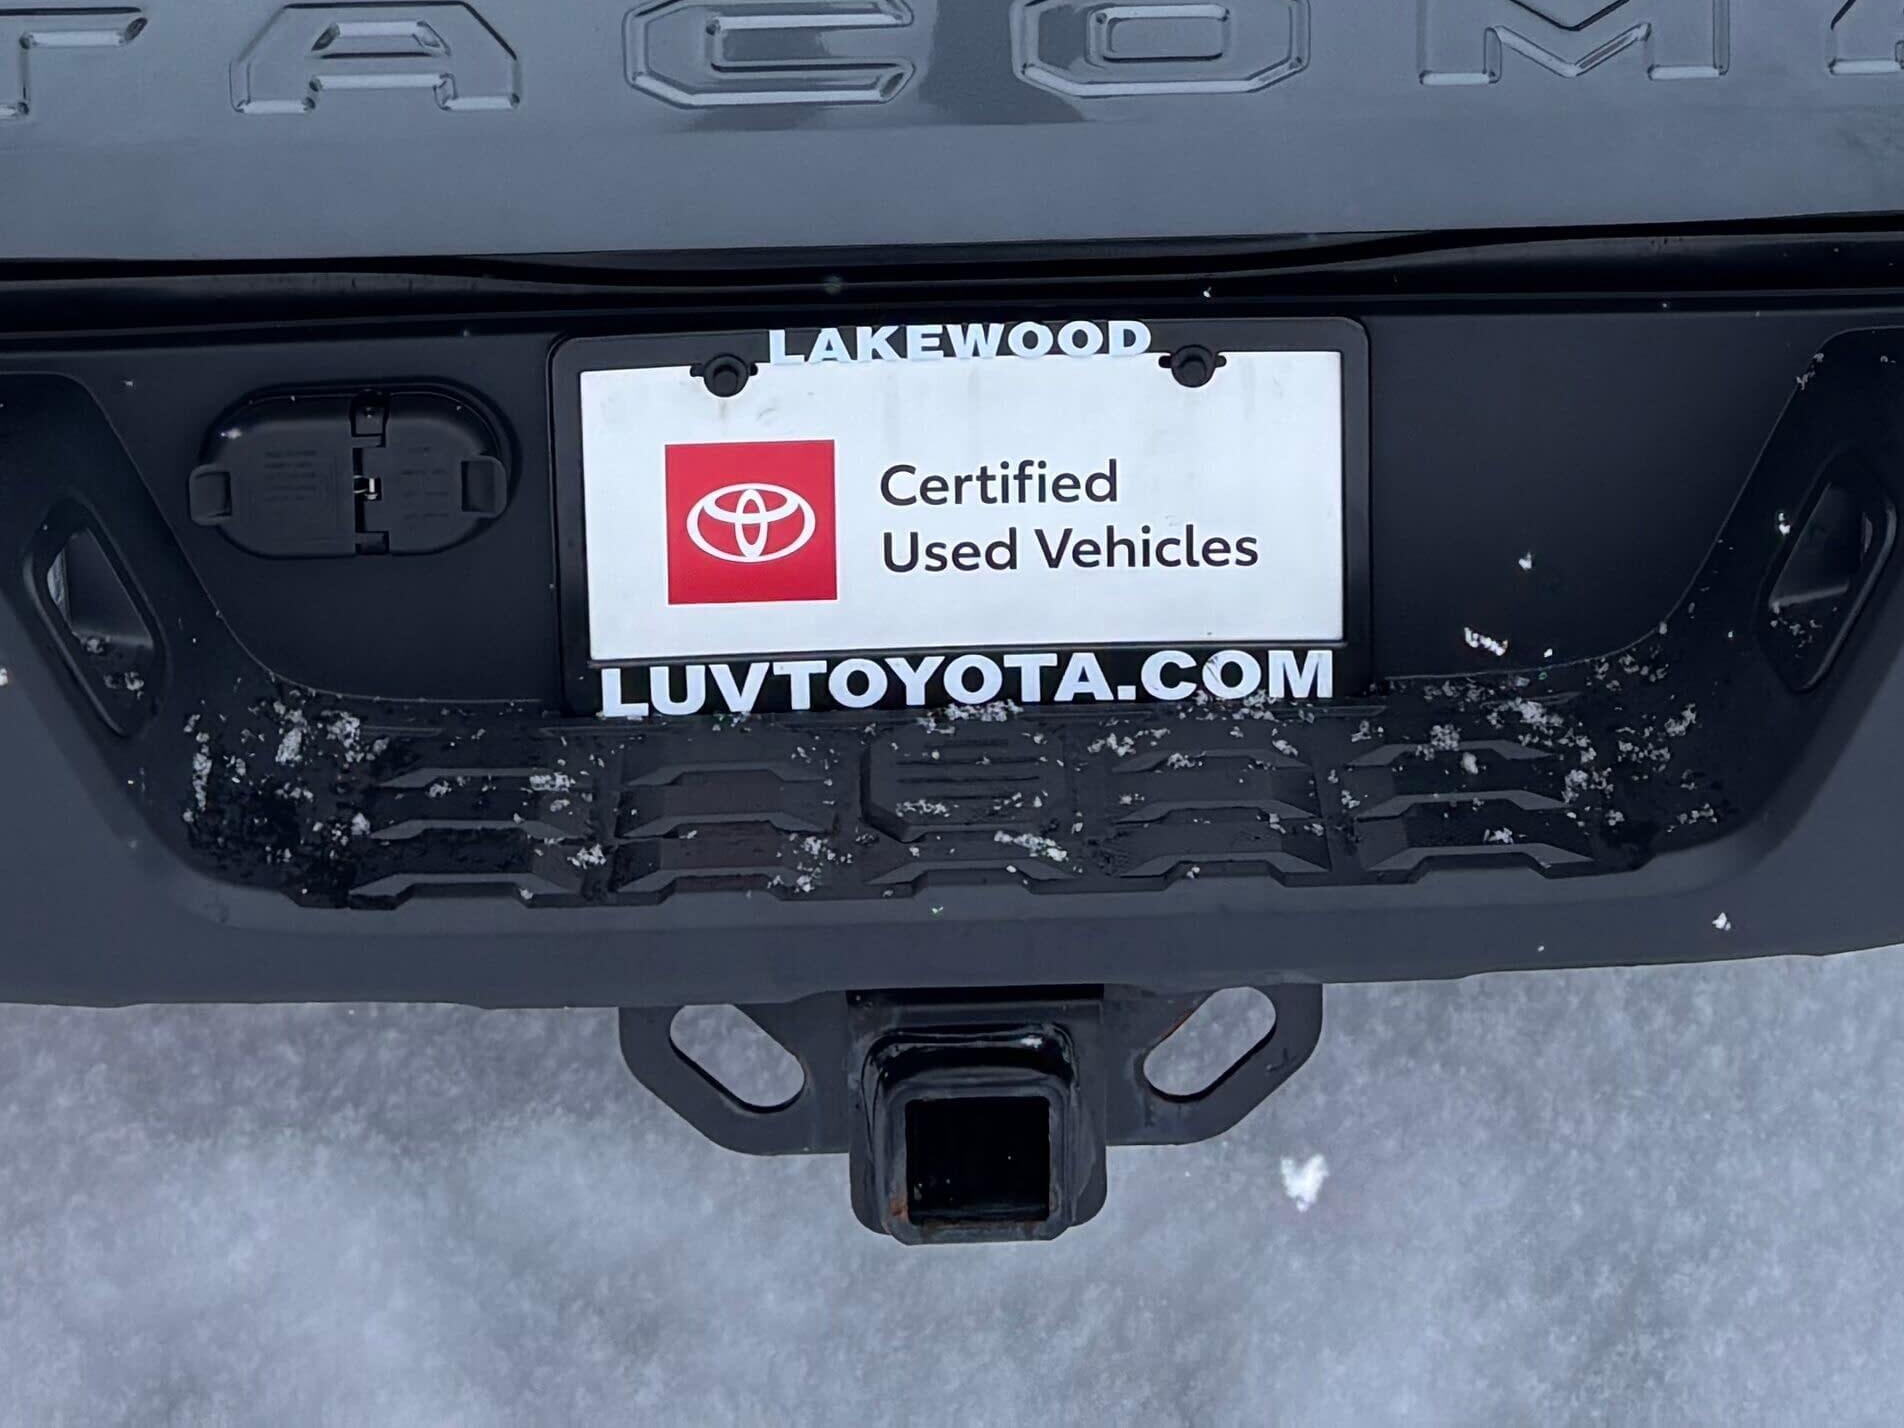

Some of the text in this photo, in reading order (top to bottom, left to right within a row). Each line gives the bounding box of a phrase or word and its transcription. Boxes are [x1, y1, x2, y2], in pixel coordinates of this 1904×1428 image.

[768, 320, 1152, 366] LAKEWOOD
[879, 458, 1118, 508] Certified
[882, 524, 1260, 573] Used Vehicles
[601, 649, 1334, 718] LUVTOYOTA.COM
